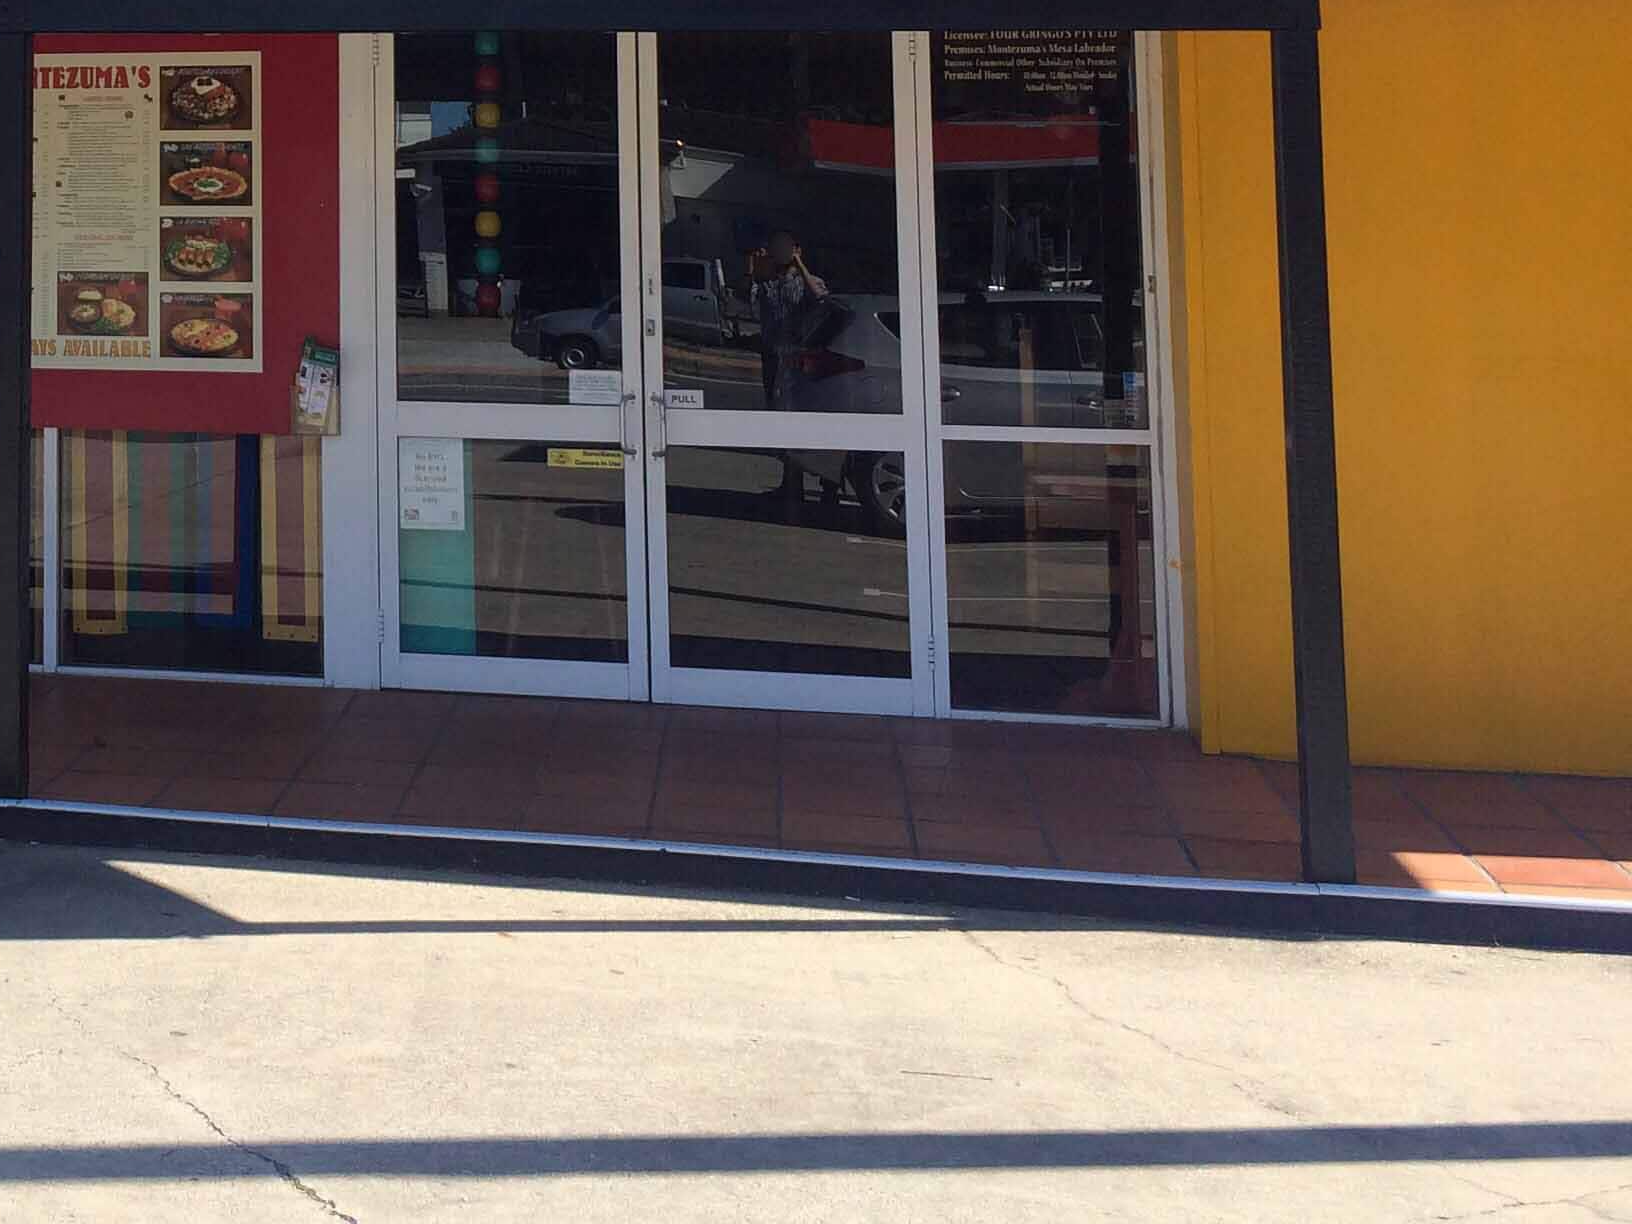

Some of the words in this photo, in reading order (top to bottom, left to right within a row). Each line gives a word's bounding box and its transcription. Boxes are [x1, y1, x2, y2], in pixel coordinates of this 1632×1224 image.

[33, 65, 151, 89] TEZUMA'S
[63, 339, 152, 358] AVAILABLE
[671, 394, 697, 404] PULL
